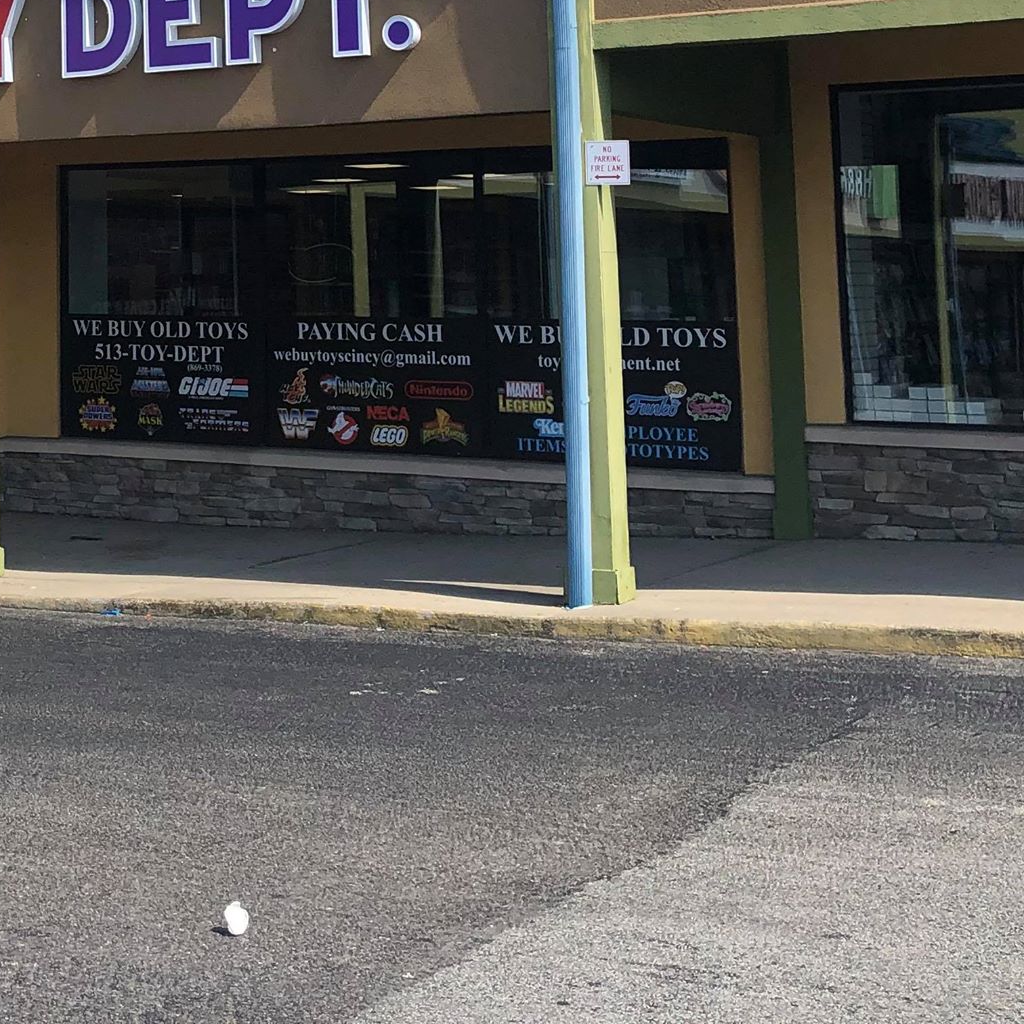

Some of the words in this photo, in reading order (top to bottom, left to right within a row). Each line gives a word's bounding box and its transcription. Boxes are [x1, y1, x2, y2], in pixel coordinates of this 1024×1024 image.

[593, 155, 621, 163] PARKING
[590, 164, 604, 172] FIRE
[73, 320, 103, 337] WE
[107, 320, 146, 338] BUY
[150, 321, 191, 339] OLD
[195, 322, 249, 340] TOYS
[296, 322, 376, 342] PAYING
[382, 323, 444, 343] CASH
[494, 325, 533, 345] WE
[621, 326, 650, 347] LD
[656, 327, 727, 349] TOYS
[95, 343, 225, 364] 513-TOY-DEPT
[273, 348, 472, 368] webuytoyscincy@gmail.com
[72, 365, 121, 380] STAR
[72, 378, 121, 395] WARS
[409, 383, 468, 398] Nintendo
[505, 381, 545, 398] MARVEL
[498, 394, 555, 415] LEGENDS
[626, 394, 682, 417] Funko
[366, 405, 411, 422] NECA
[372, 427, 406, 444] LEGO
[627, 425, 699, 442] PLOYEE
[626, 443, 710, 461] TOTYPES
